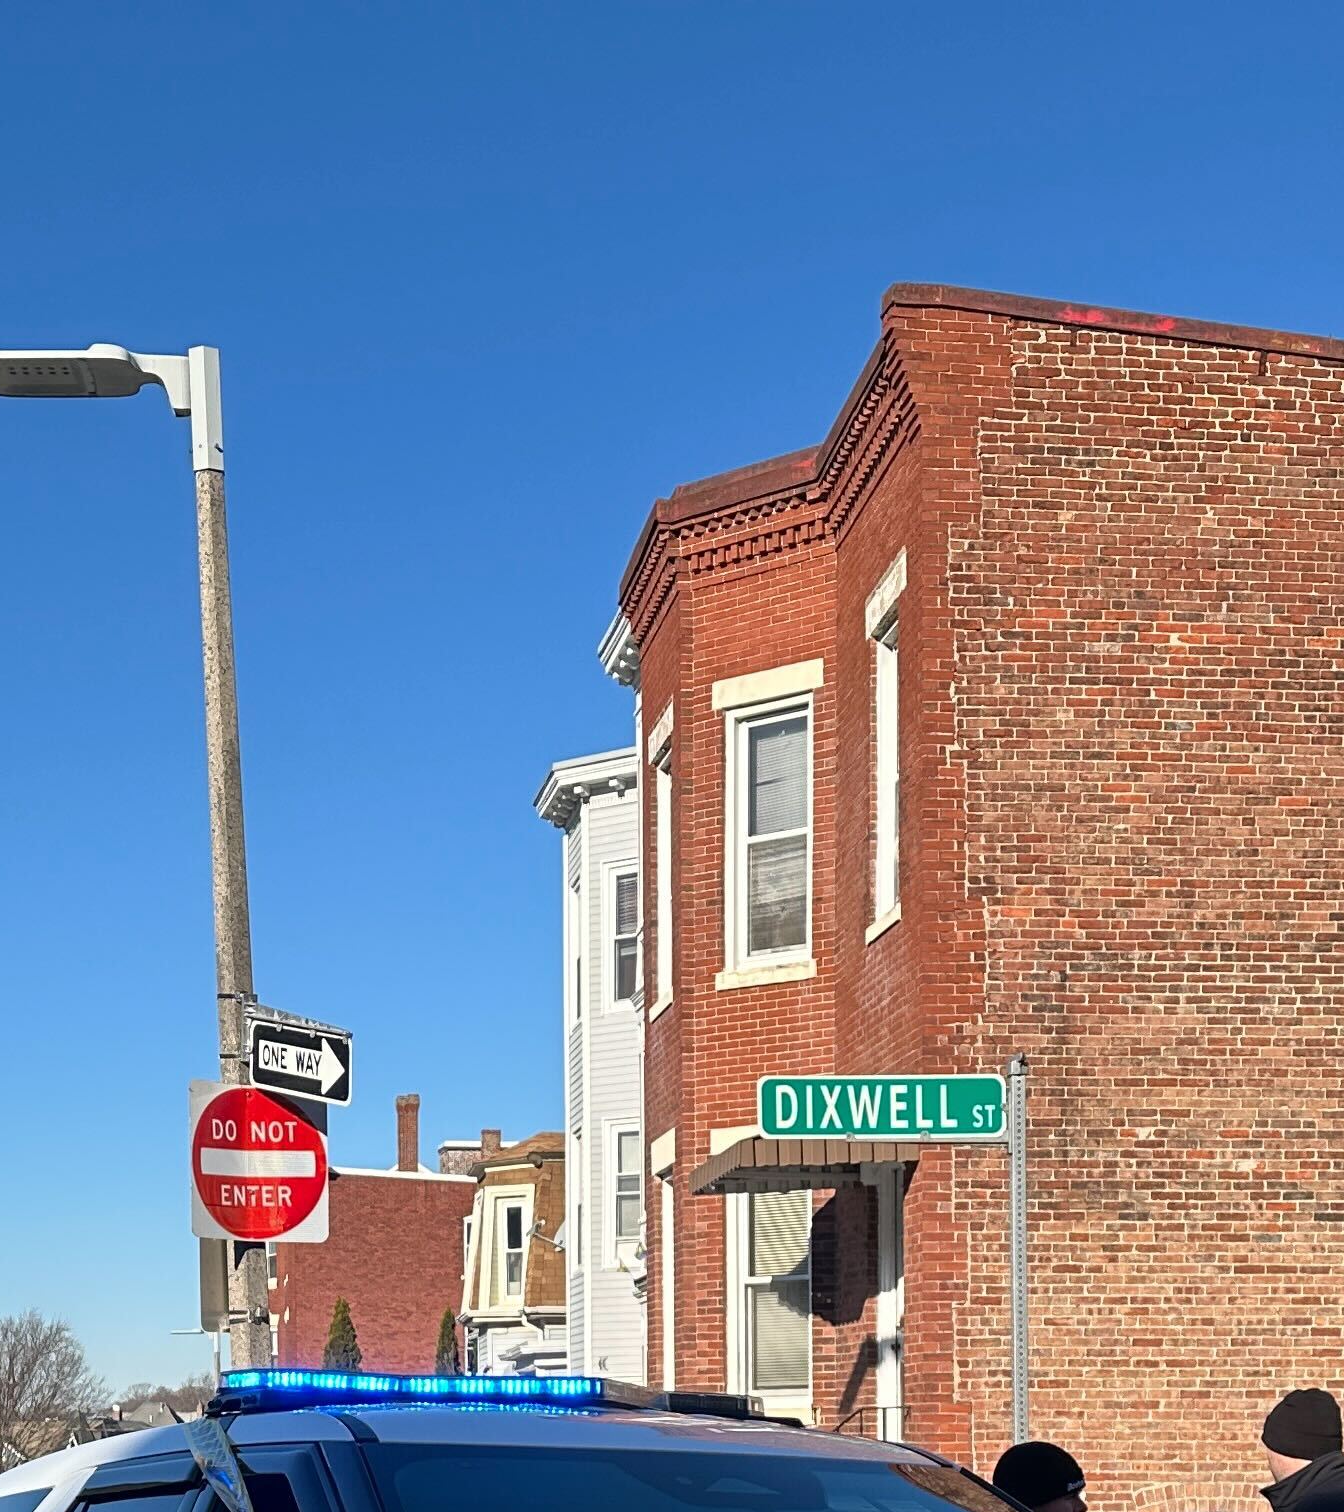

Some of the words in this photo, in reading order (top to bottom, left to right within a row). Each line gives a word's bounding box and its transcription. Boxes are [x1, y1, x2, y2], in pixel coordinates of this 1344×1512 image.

[263, 1044, 288, 1070] ONE
[296, 1050, 322, 1076] WAY
[775, 1084, 958, 1129] DIXWELL
[972, 1104, 996, 1128] ST
[211, 1118, 237, 1142] DO
[250, 1121, 298, 1143] NOT
[220, 1184, 292, 1207] ENTER
